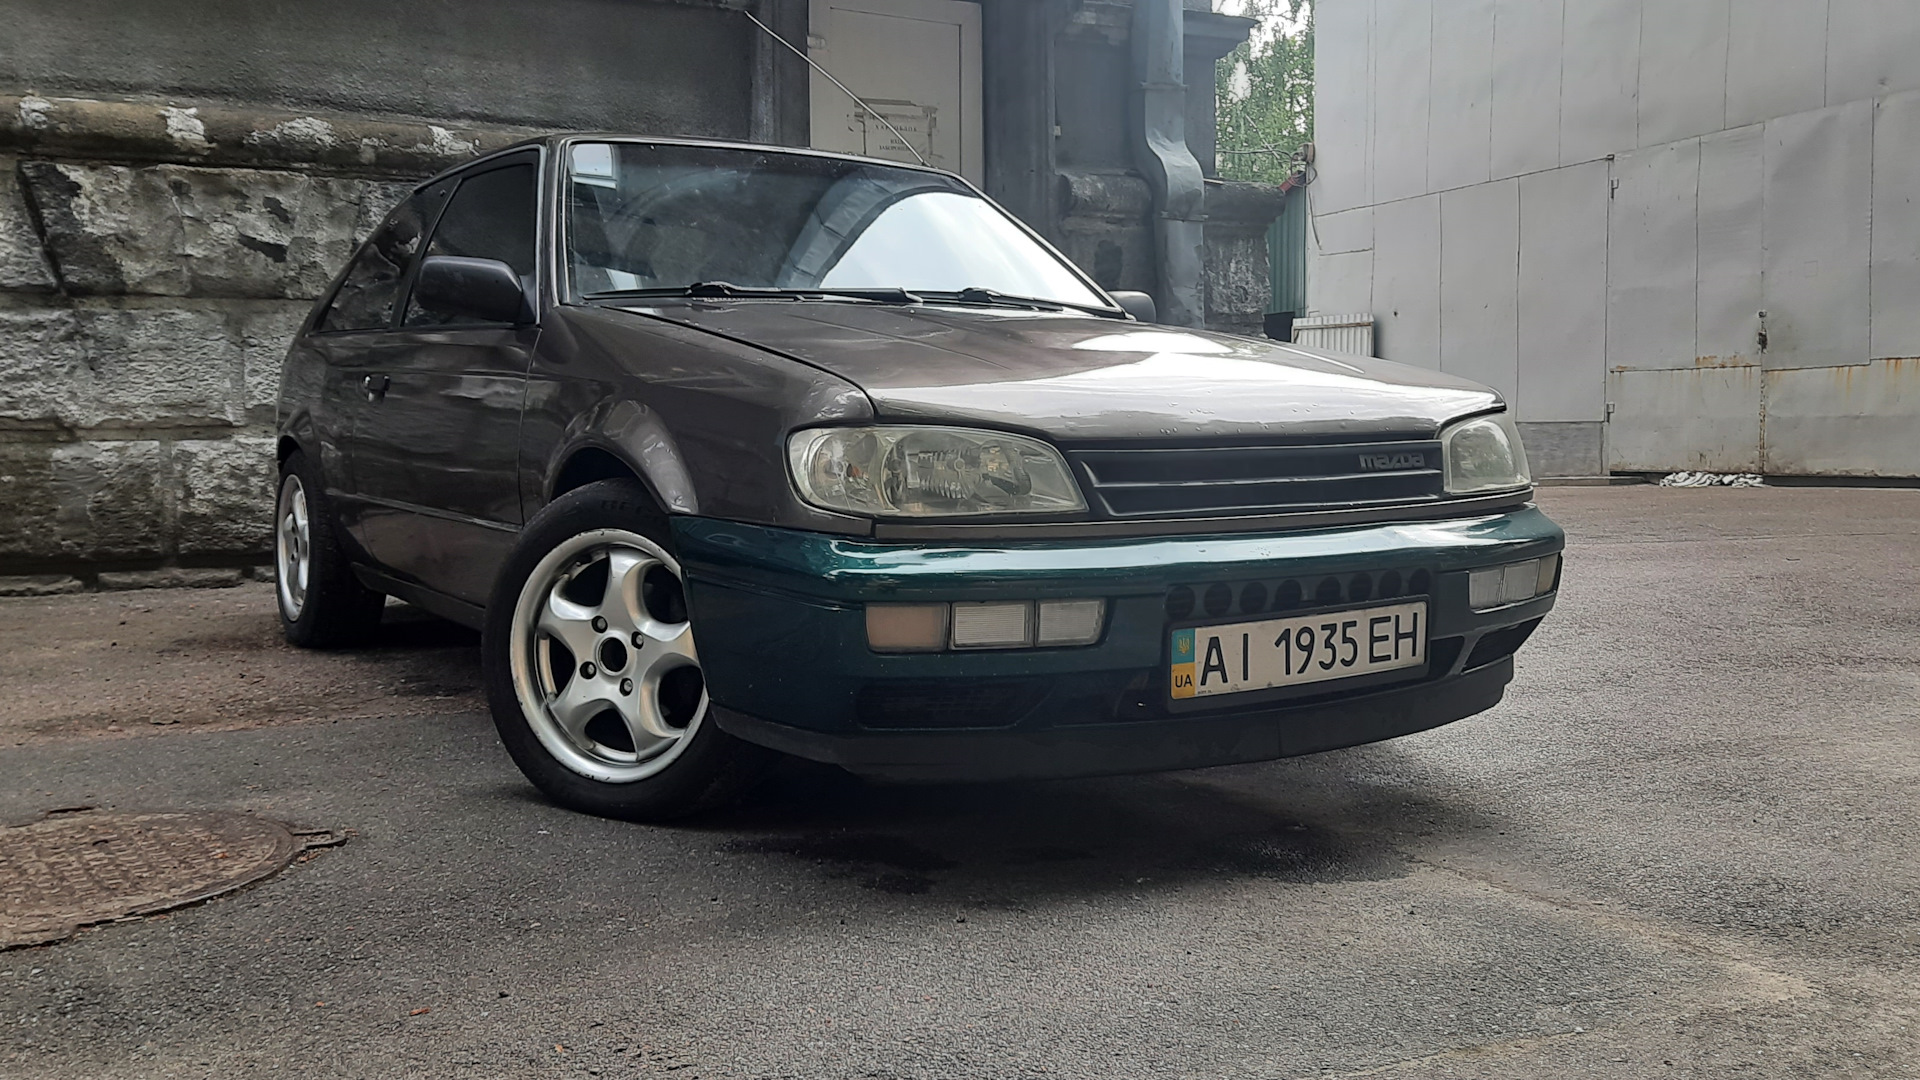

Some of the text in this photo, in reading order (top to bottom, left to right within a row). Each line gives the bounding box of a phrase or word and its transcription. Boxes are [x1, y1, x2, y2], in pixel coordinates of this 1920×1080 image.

[1274, 620, 1358, 675] 1935
[1369, 612, 1418, 664] EH
[1174, 673, 1193, 688] UA
